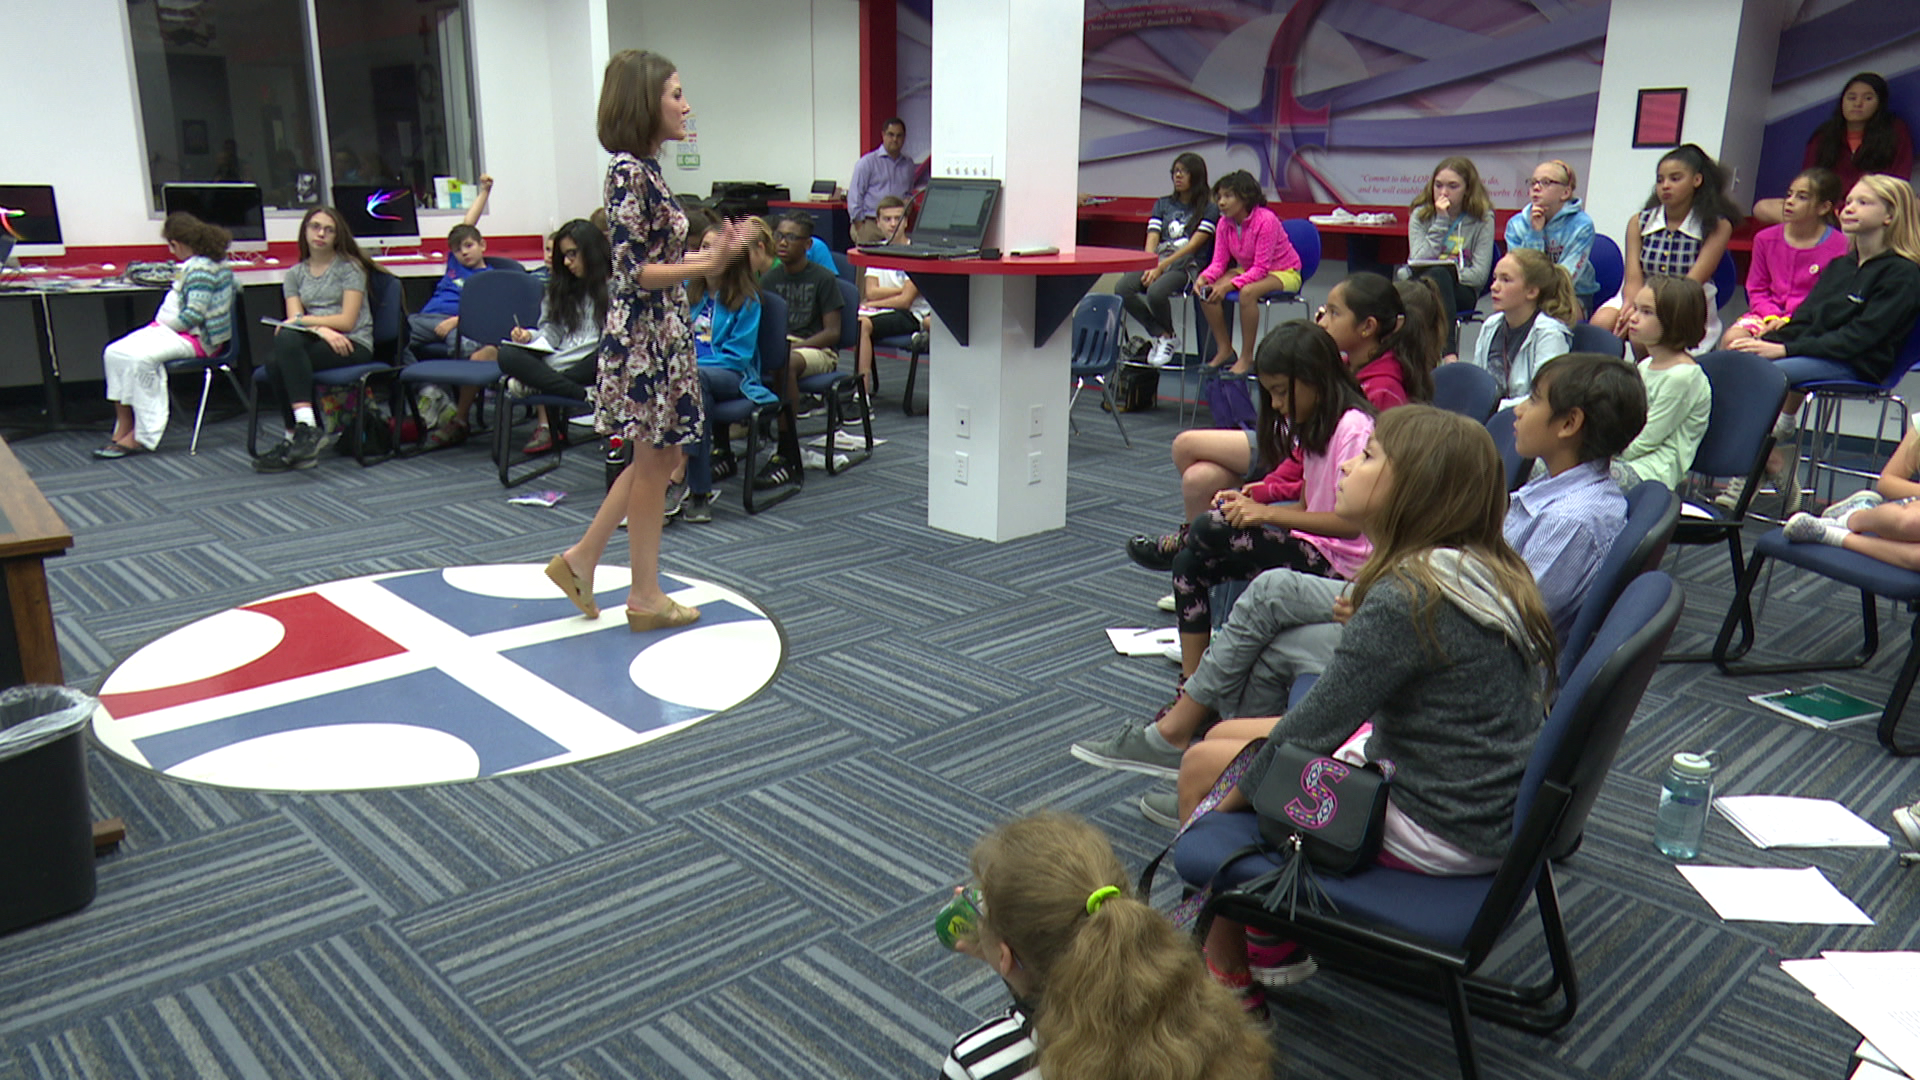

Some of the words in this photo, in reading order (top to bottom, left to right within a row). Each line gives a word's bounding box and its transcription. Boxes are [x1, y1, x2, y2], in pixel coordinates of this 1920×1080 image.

[1391, 174, 1399, 183] to
[1400, 174, 1411, 183] the
[1412, 174, 1430, 184] LOR
[1358, 185, 1372, 194] and
[1372, 185, 1381, 194] he
[1382, 185, 1396, 195] will
[1284, 757, 1350, 829] S
